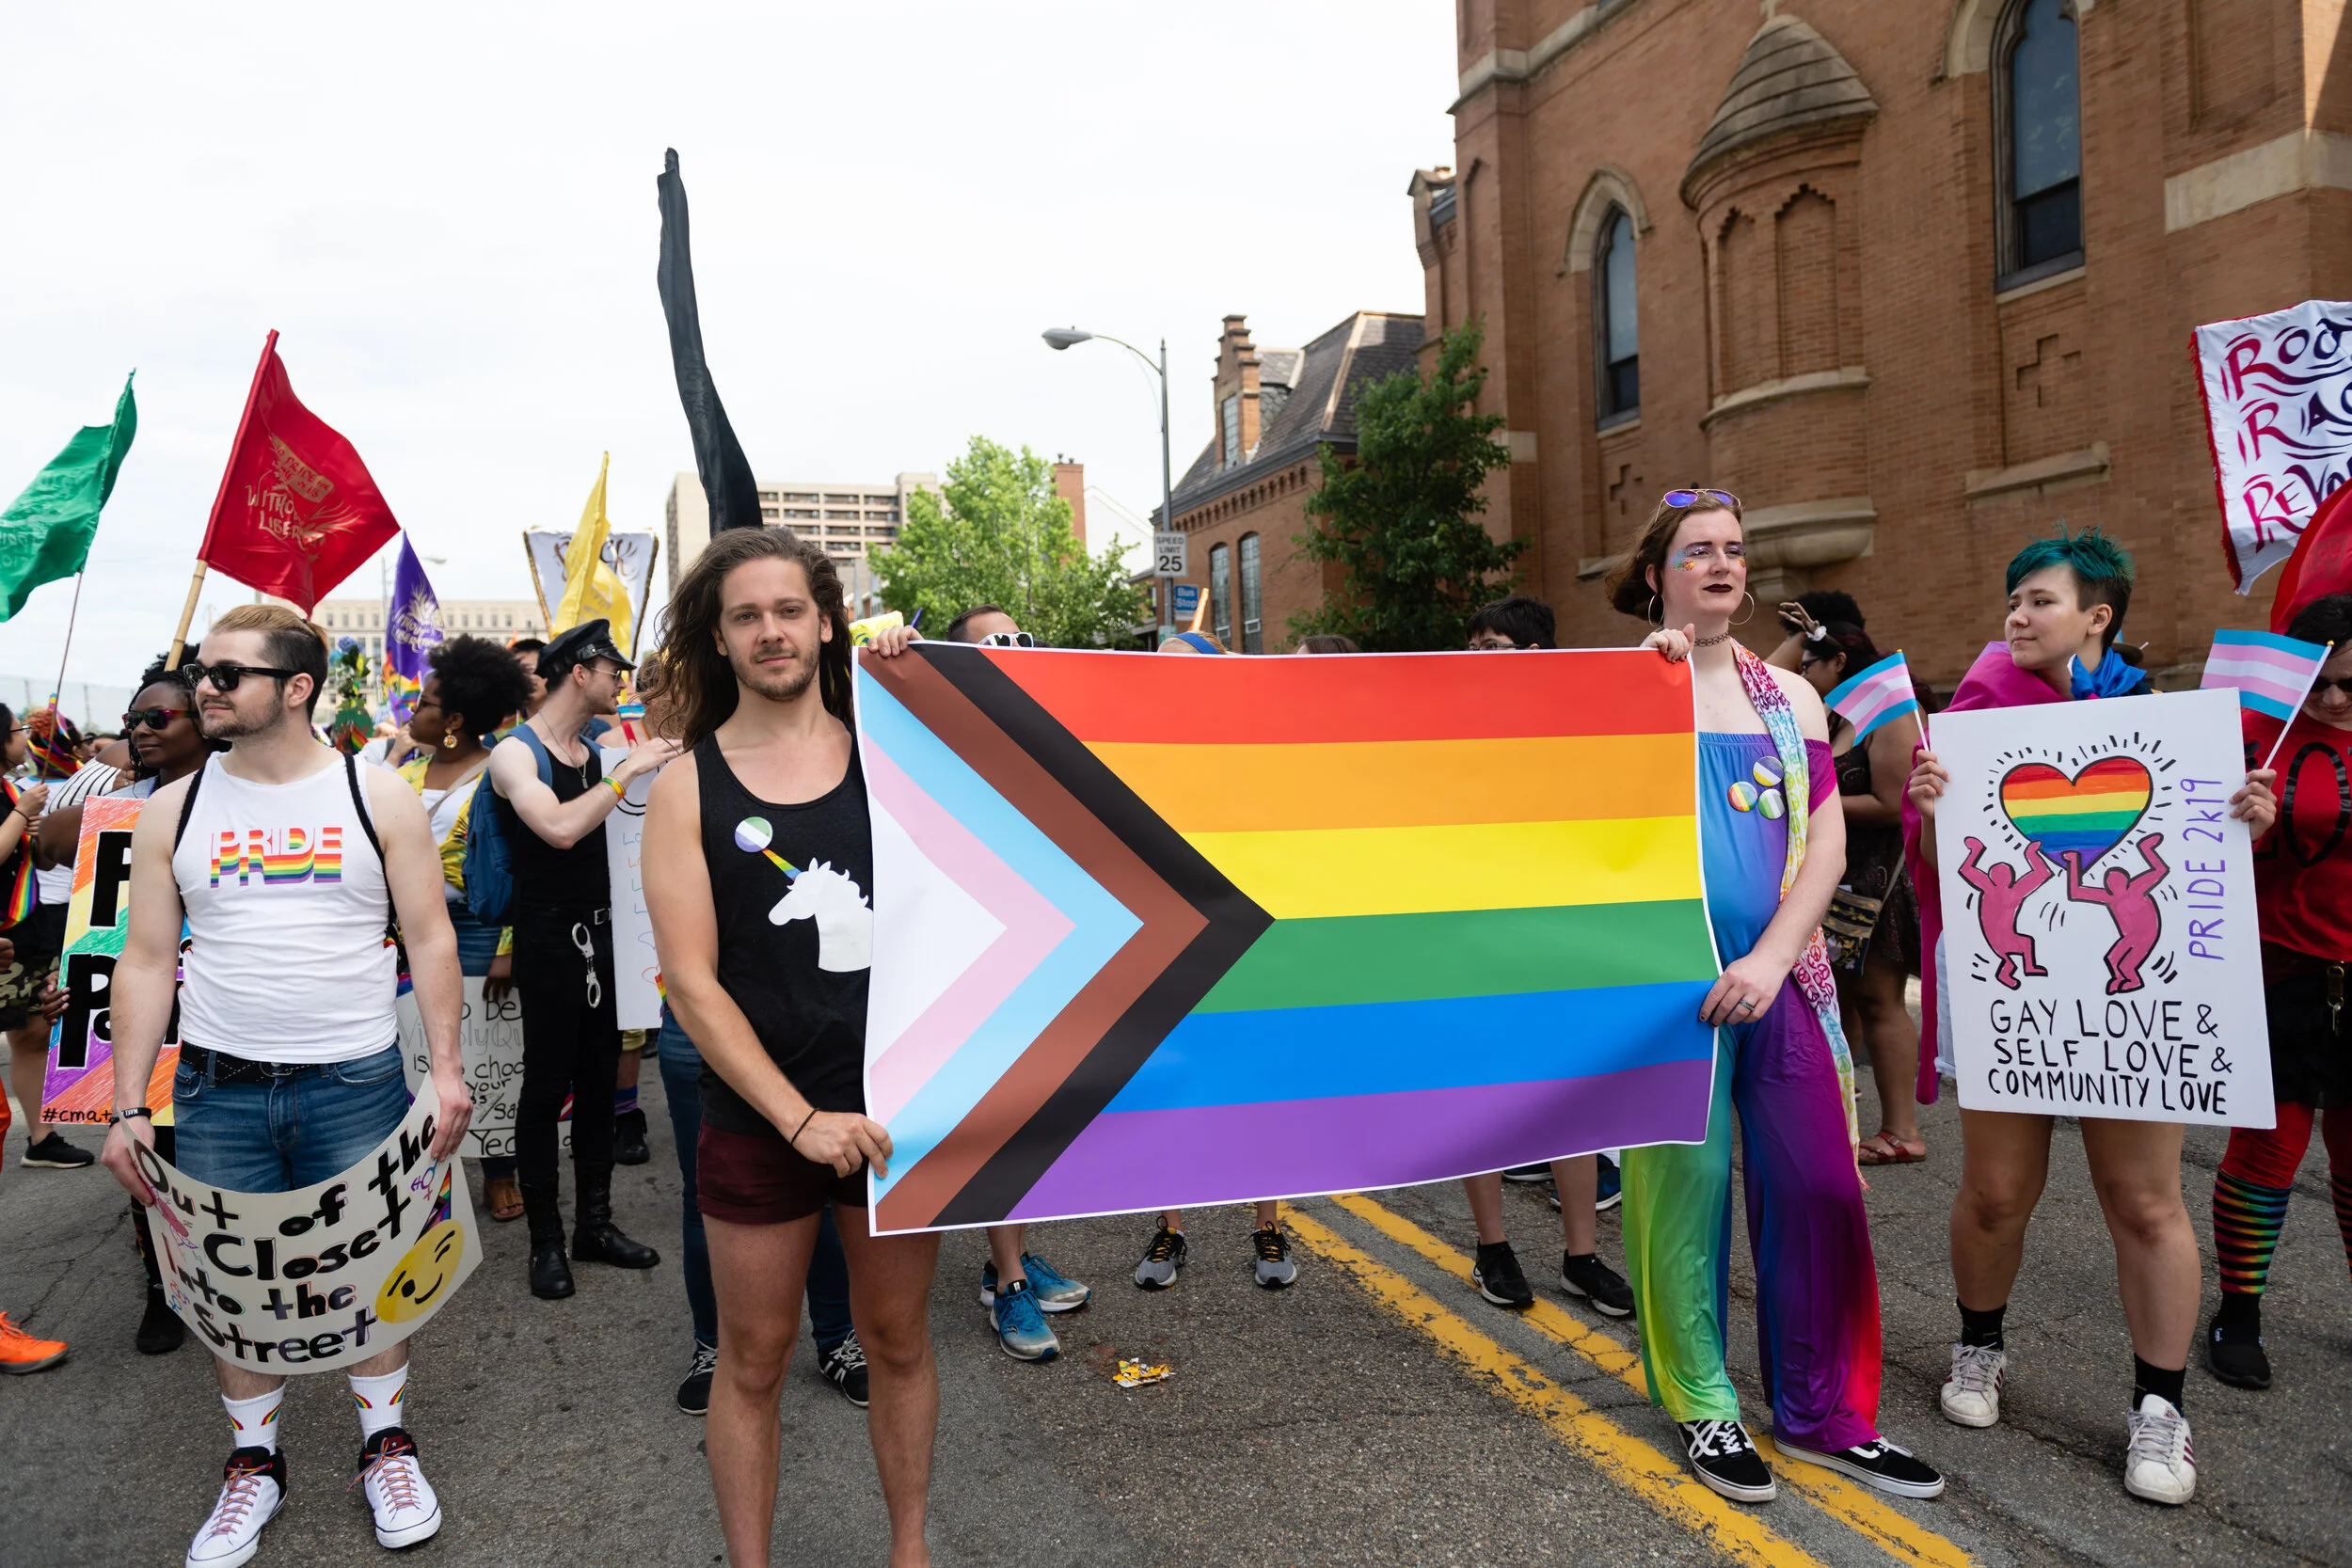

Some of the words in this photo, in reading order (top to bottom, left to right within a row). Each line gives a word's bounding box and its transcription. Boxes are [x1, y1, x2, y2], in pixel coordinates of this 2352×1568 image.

[259, 510, 307, 550] LIBER
[1156, 536, 1184, 545] SPEED
[1159, 556, 1182, 572] 25
[1176, 598, 1197, 609] Stop
[1177, 587, 1195, 596] Bus
[210, 827, 342, 888] PRIDE
[2185, 860, 2225, 960] PRIDE
[1991, 999, 2057, 1036] GAY
[2076, 999, 2183, 1041] LOVE
[2197, 1004, 2218, 1038] &
[474, 1054, 525, 1079] choo
[1994, 1037, 2079, 1068] SELF
[2104, 1039, 2200, 1079] LOVE
[2211, 1046, 2233, 1073] &
[1988, 1069, 2150, 1108] COMMUNITY
[2162, 1079, 2227, 1115] LOVE
[134, 1139, 242, 1230] Out
[278, 1181, 348, 1237] of
[368, 1112, 437, 1196] the
[203, 1182, 411, 1281] Closet
[162, 1233, 246, 1315] Into
[262, 1281, 357, 1321] the
[193, 1303, 378, 1363] Street
